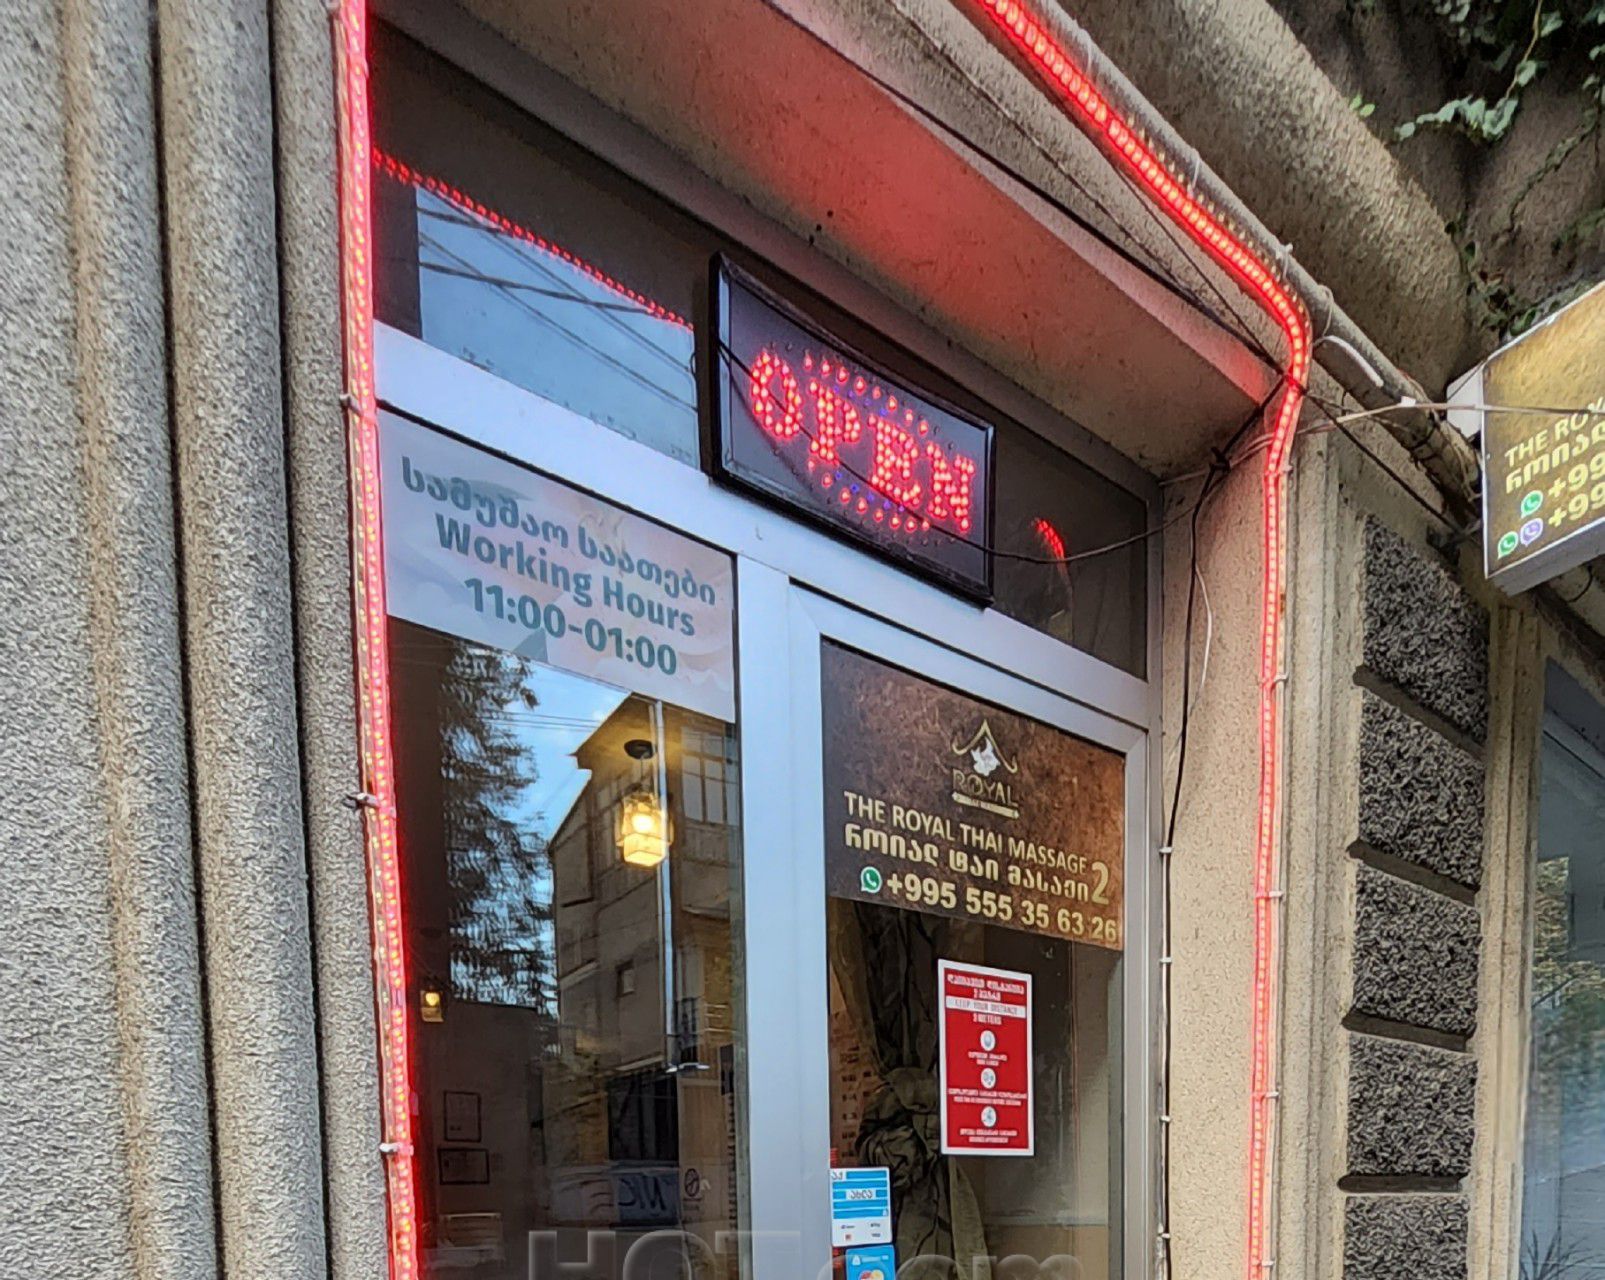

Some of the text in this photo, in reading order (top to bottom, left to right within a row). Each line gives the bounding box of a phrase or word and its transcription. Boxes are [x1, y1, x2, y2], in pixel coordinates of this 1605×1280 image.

[750, 347, 975, 534] OPEN
[1504, 429, 1548, 468] THE
[401, 456, 716, 606] სამუშაო საათები
[435, 512, 696, 636] Working Hours
[464, 577, 677, 675] 11:00-01:00
[952, 768, 1019, 808] ROYAL
[844, 791, 886, 824] THE
[892, 805, 956, 842] ROYAL
[959, 823, 1003, 853] THAI
[1008, 837, 1088, 874] MASSAGE
[1091, 861, 1110, 905] 2
[887, 873, 1118, 942] +995 555 35 63 26
